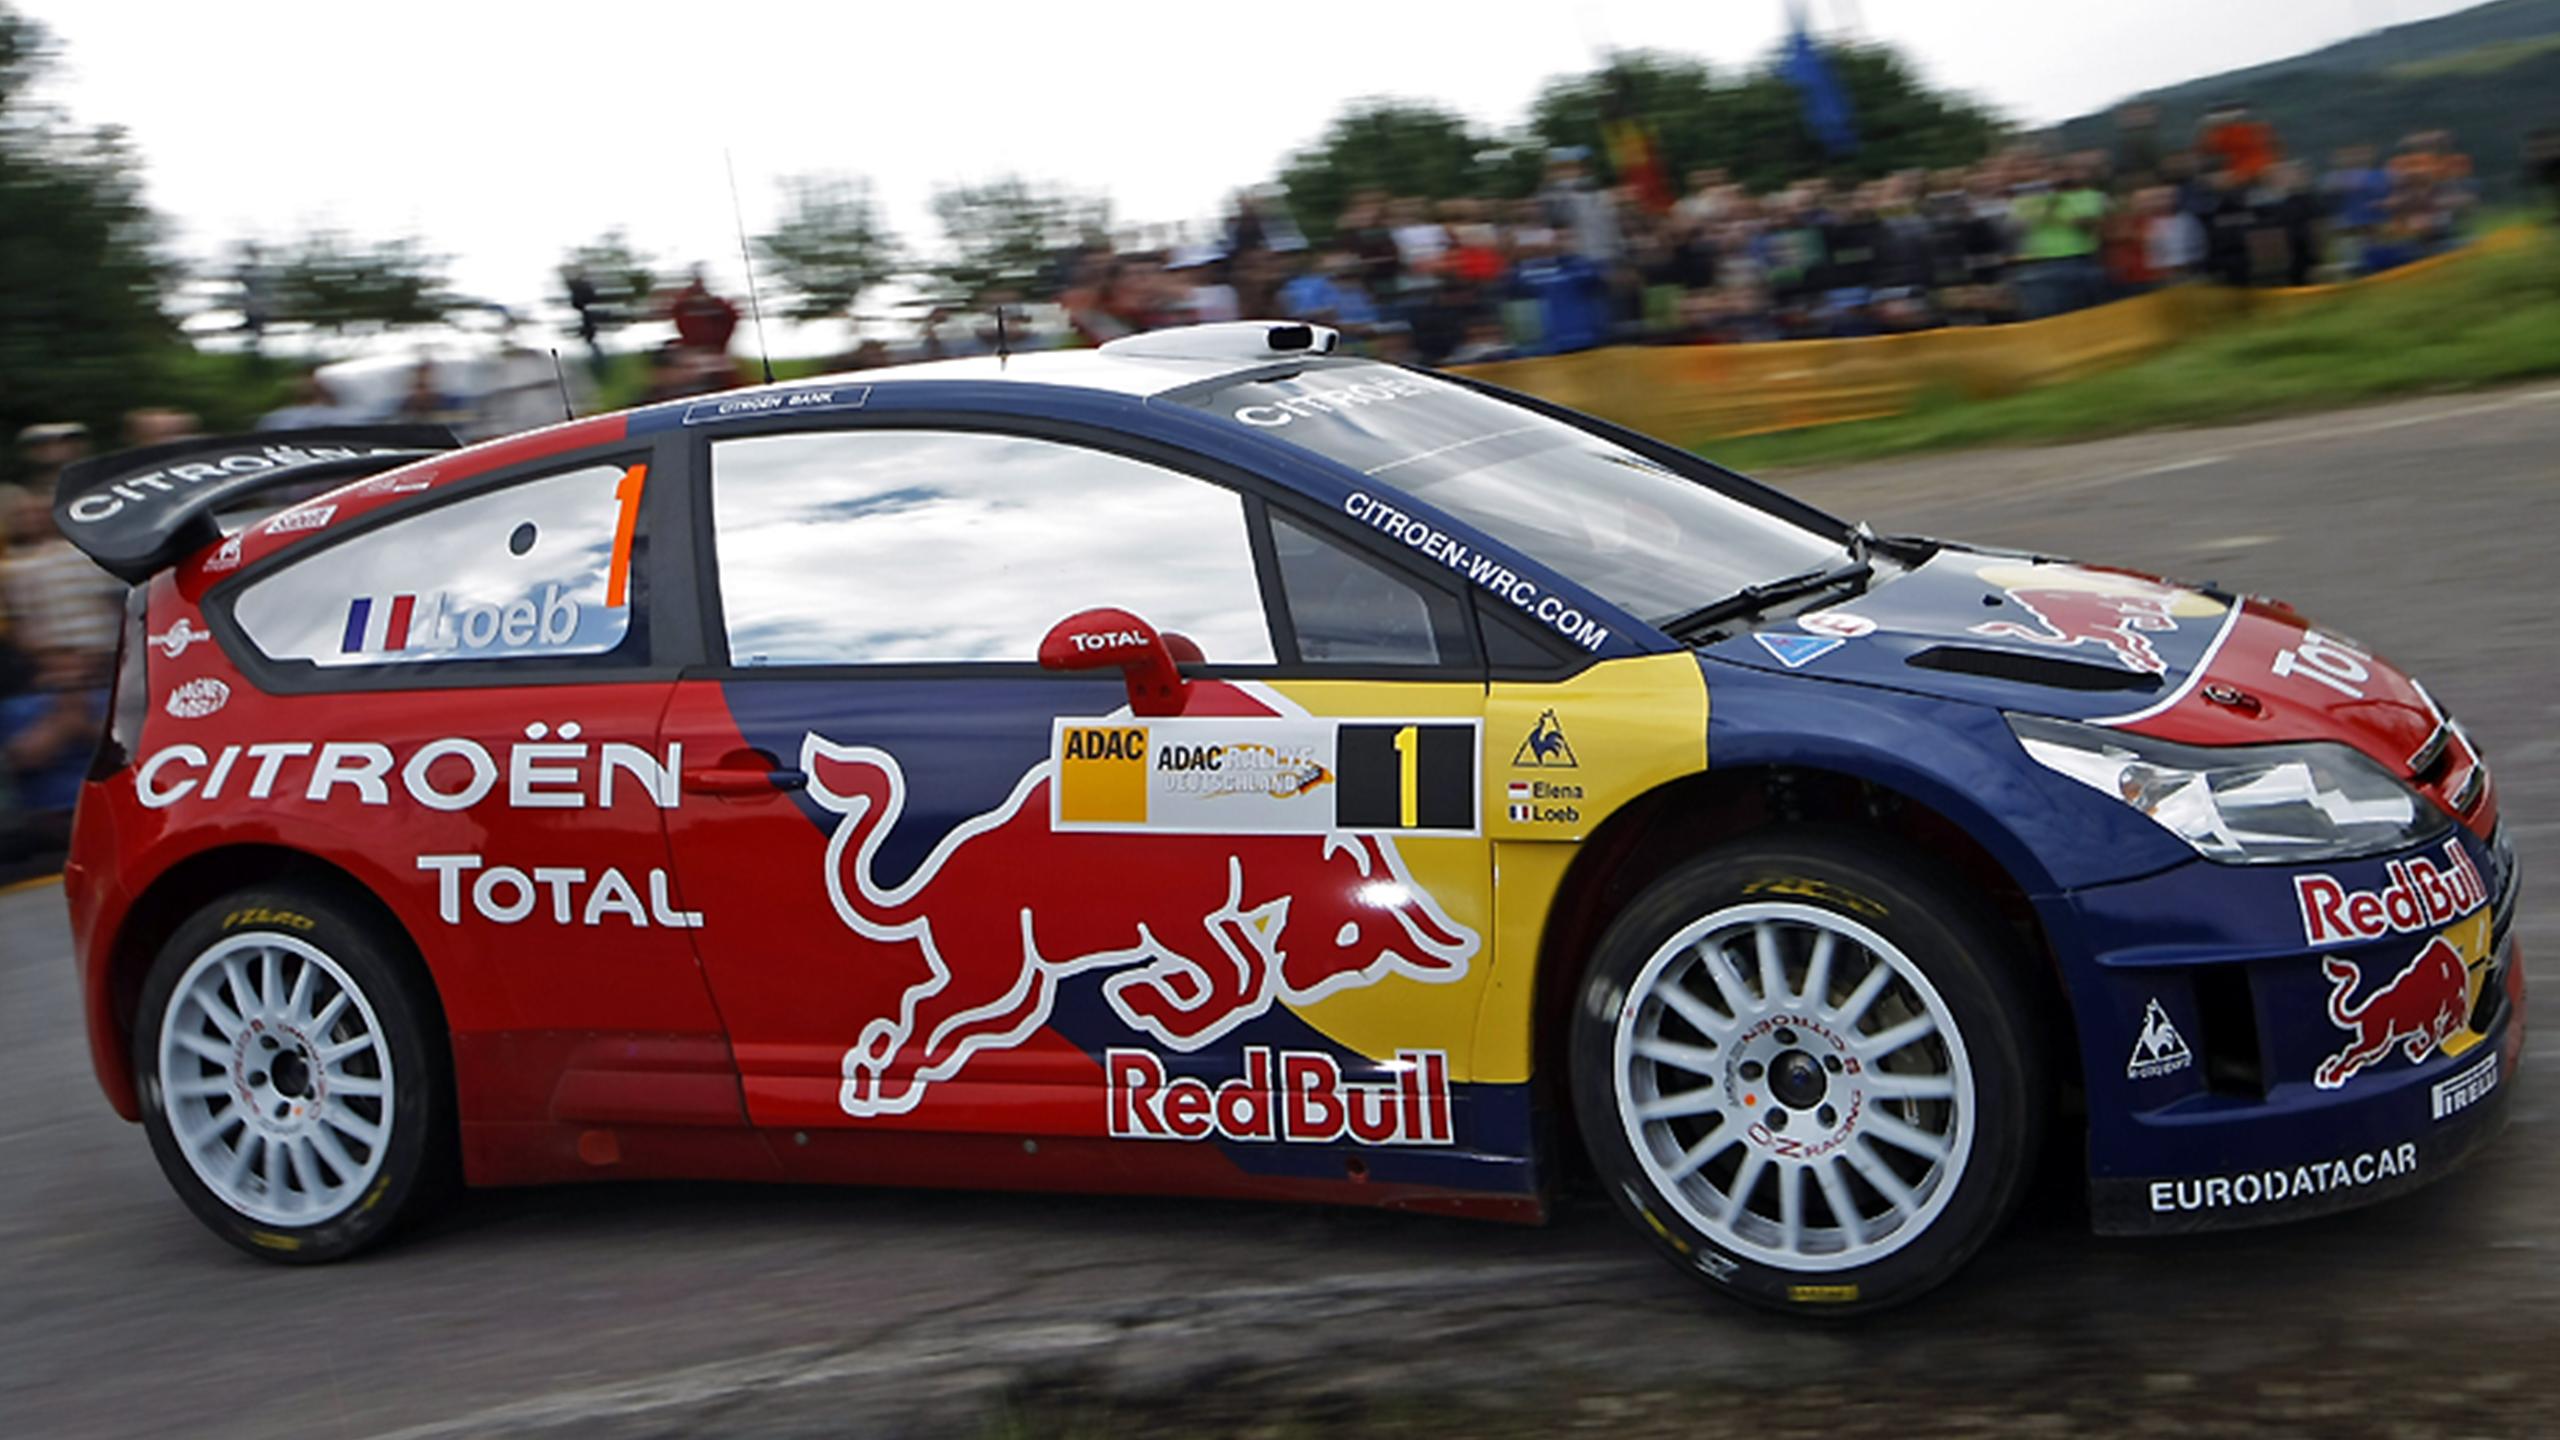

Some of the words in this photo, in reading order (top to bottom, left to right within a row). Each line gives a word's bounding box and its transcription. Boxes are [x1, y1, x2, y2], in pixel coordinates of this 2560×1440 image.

[788, 391, 833, 406] BANK
[604, 463, 648, 608] 1
[1344, 491, 1610, 653] CITROEN-WRC.COM
[424, 583, 581, 648] Loeb
[1069, 629, 1149, 652] TOTAL
[2271, 629, 2373, 699] TOT
[136, 721, 683, 811] CITROËN
[1064, 729, 1146, 761] ADAC
[1157, 745, 1223, 772] ADAC
[1394, 725, 1419, 828] 1
[1163, 770, 1298, 794] DEUTSCHLAND
[1533, 781, 1584, 800] Elena
[1533, 804, 1580, 823] Loeb
[417, 853, 705, 928] TOTAL
[1106, 1046, 1277, 1141] Red
[1280, 1049, 1455, 1145] Bull
[2432, 1051, 2498, 1119] PIRELLI
[2150, 1142, 2417, 1212] EURODATACAR
